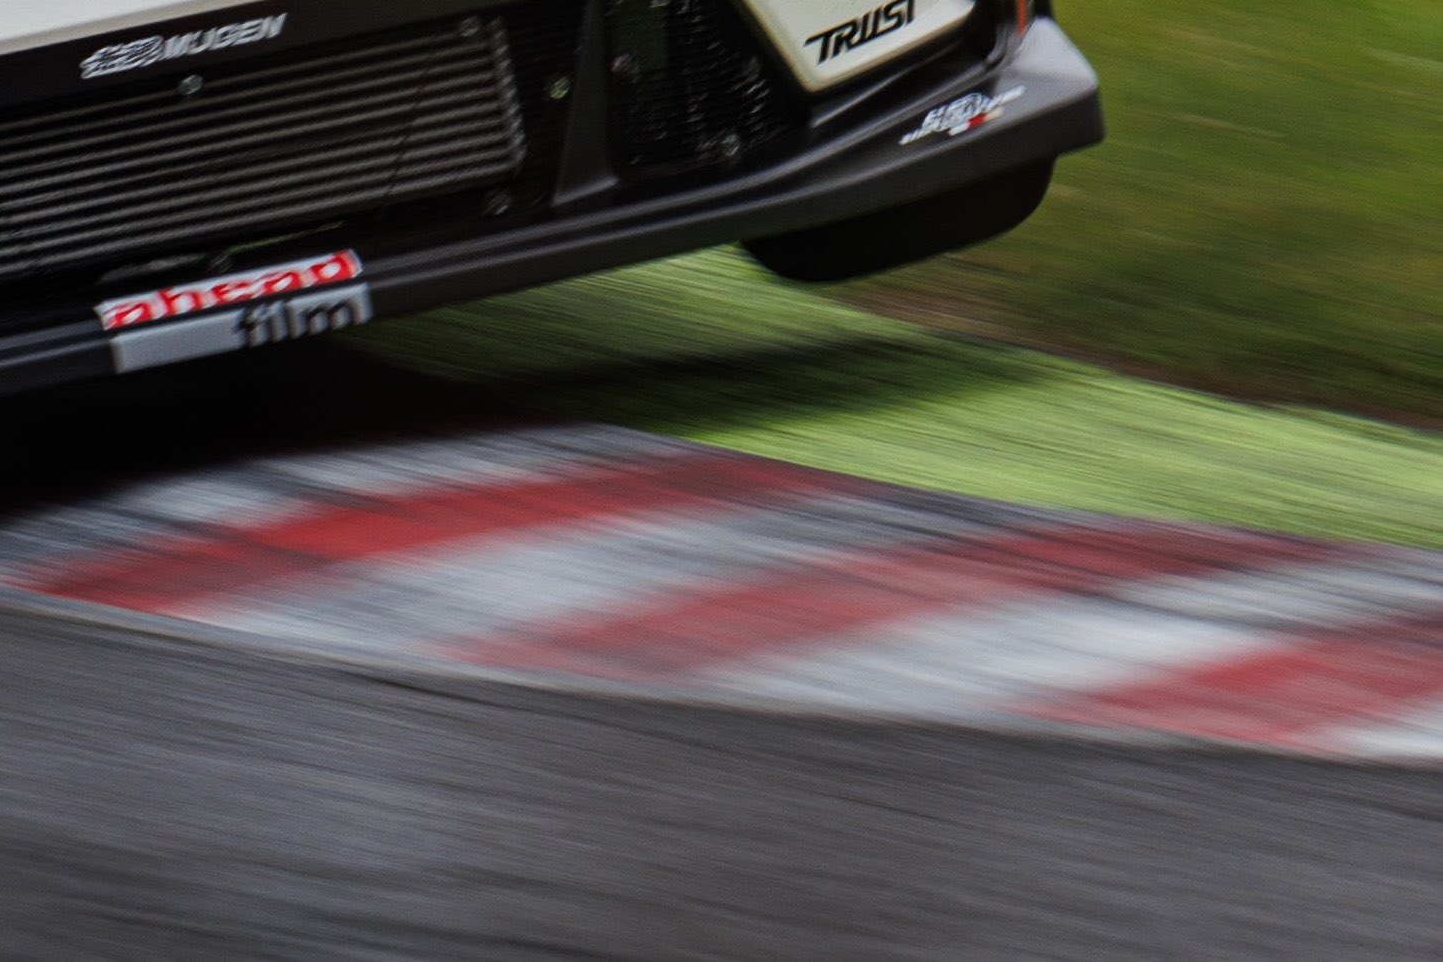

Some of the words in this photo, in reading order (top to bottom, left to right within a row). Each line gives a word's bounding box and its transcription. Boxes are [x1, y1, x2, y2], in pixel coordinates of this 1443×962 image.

[163, 13, 288, 61] MUGEN
[105, 250, 358, 329] ahead
[232, 297, 358, 348] film
